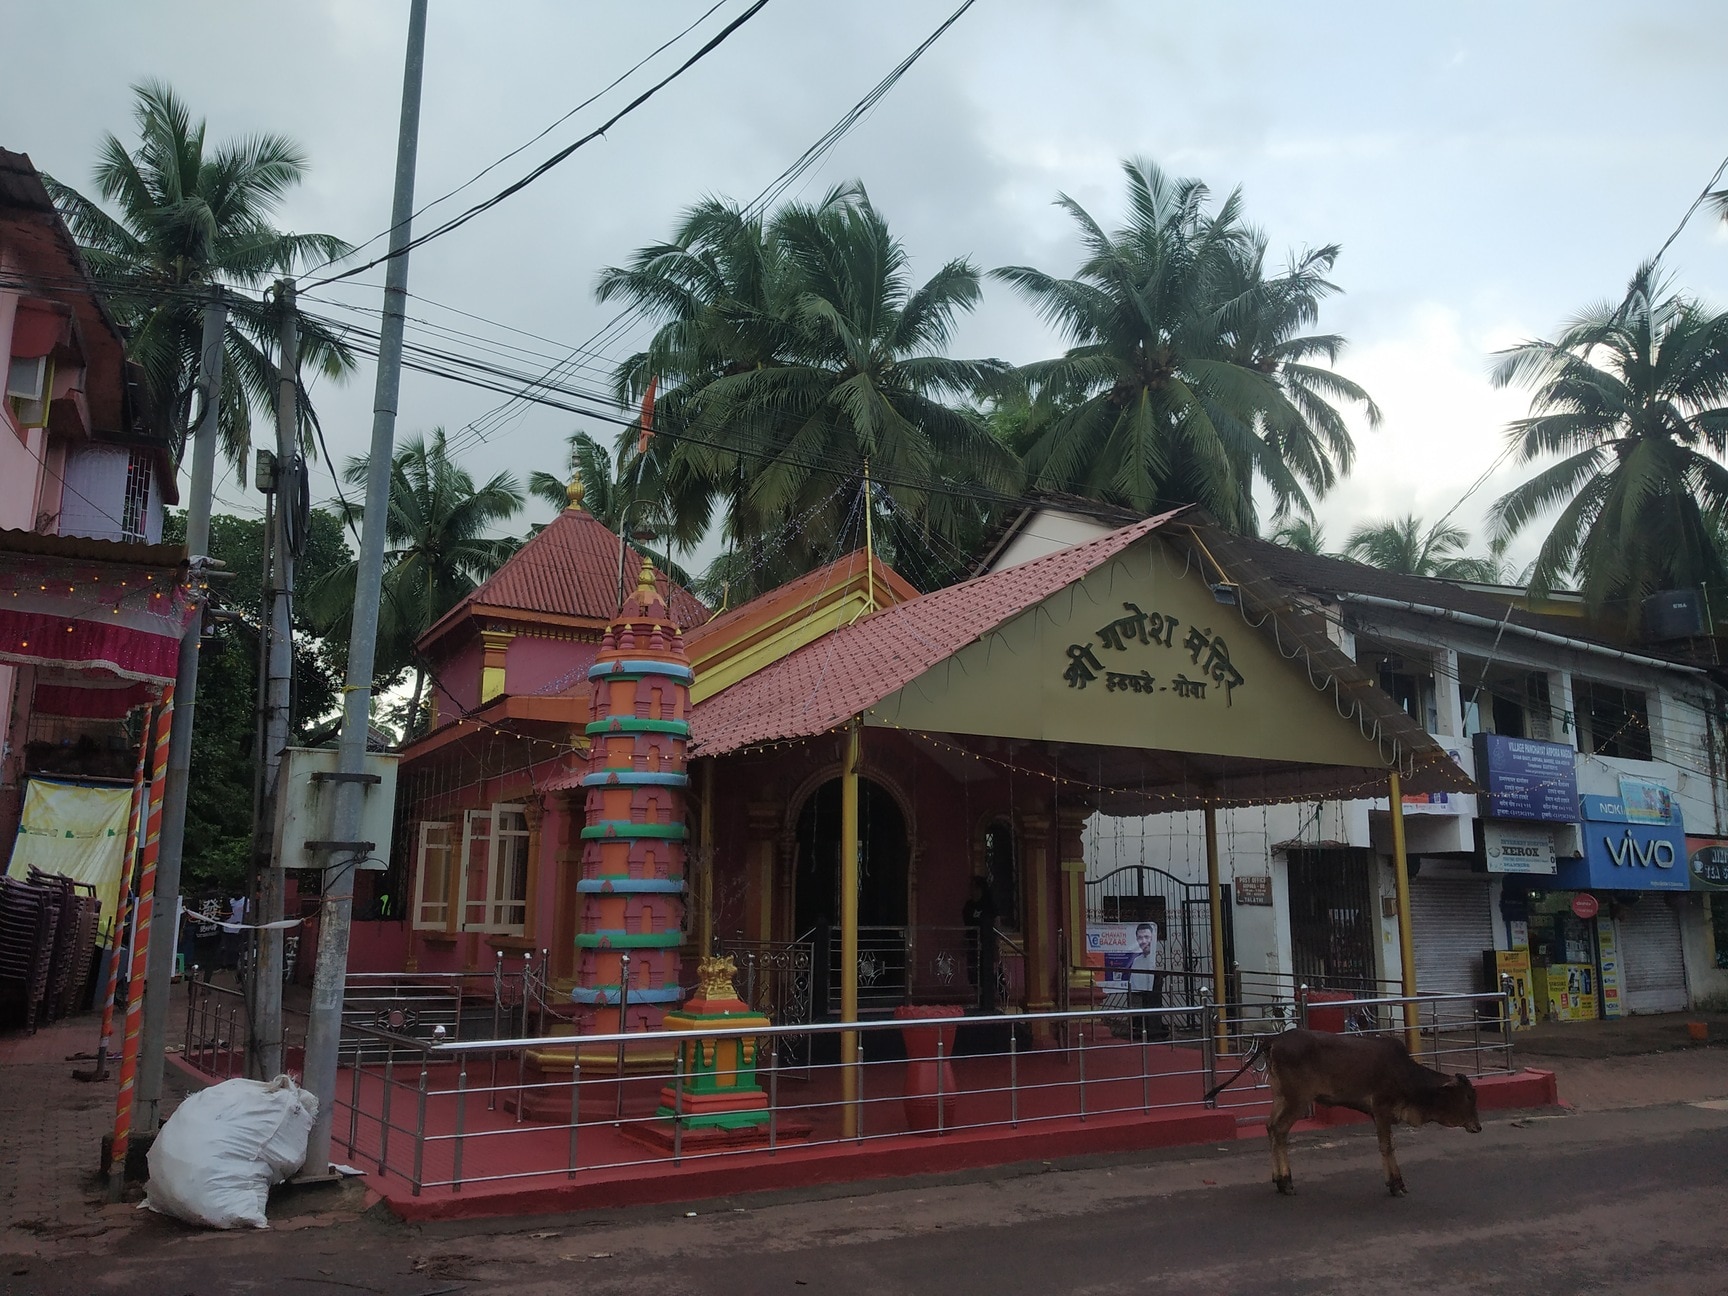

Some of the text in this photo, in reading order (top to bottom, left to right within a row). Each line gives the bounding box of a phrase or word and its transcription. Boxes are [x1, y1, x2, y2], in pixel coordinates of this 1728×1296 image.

[1063, 642, 1106, 689] श्री
[1095, 602, 1180, 651] गणेश
[1172, 673, 1208, 699] गोवा
[1508, 742, 1525, 753] VILLAGE
[1524, 743, 1546, 755] PANCHAYAT
[1546, 746, 1561, 757] ARPORA
[1599, 802, 1625, 815] NOKI
[1502, 846, 1540, 857] XEROX
